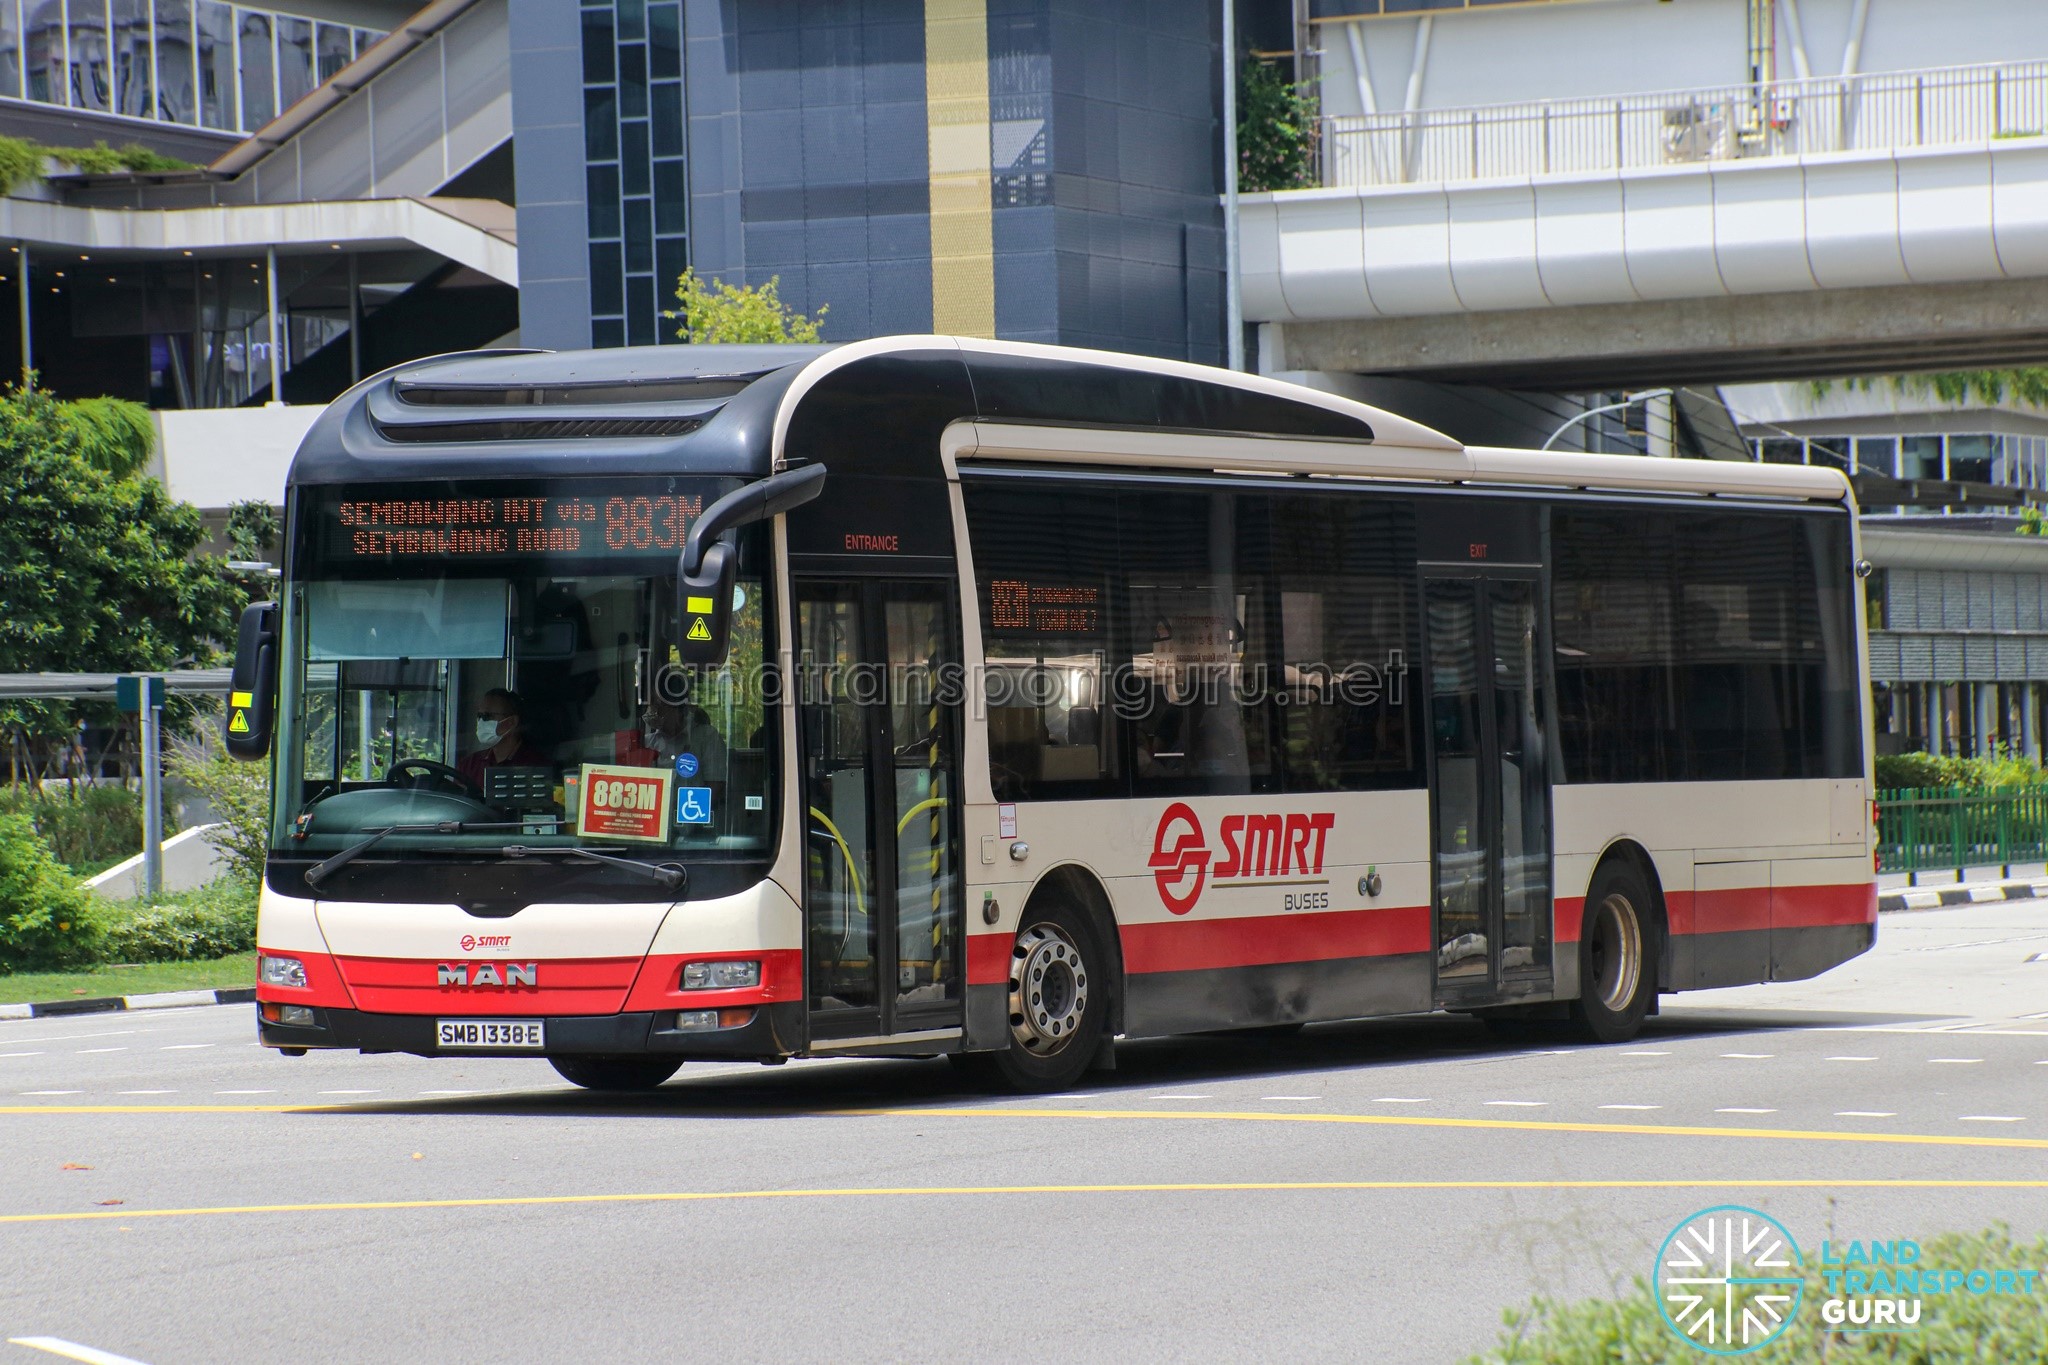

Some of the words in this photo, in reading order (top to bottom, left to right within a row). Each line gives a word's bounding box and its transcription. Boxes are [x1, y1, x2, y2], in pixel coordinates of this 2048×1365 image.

[339, 499, 495, 526] SEMBAWANG
[504, 498, 548, 523] INT
[556, 498, 597, 522] via
[605, 495, 701, 550] 883M
[352, 528, 508, 555] SEMBAWANG
[517, 527, 581, 552] ROAD
[845, 534, 898, 551] ENTRANCE
[1469, 543, 1487, 558] EXIT
[593, 780, 657, 811] 883M
[1212, 812, 1336, 879] SMRT
[1284, 892, 1329, 911] BUSES
[477, 935, 512, 946] SMRT
[437, 962, 538, 986] MAN
